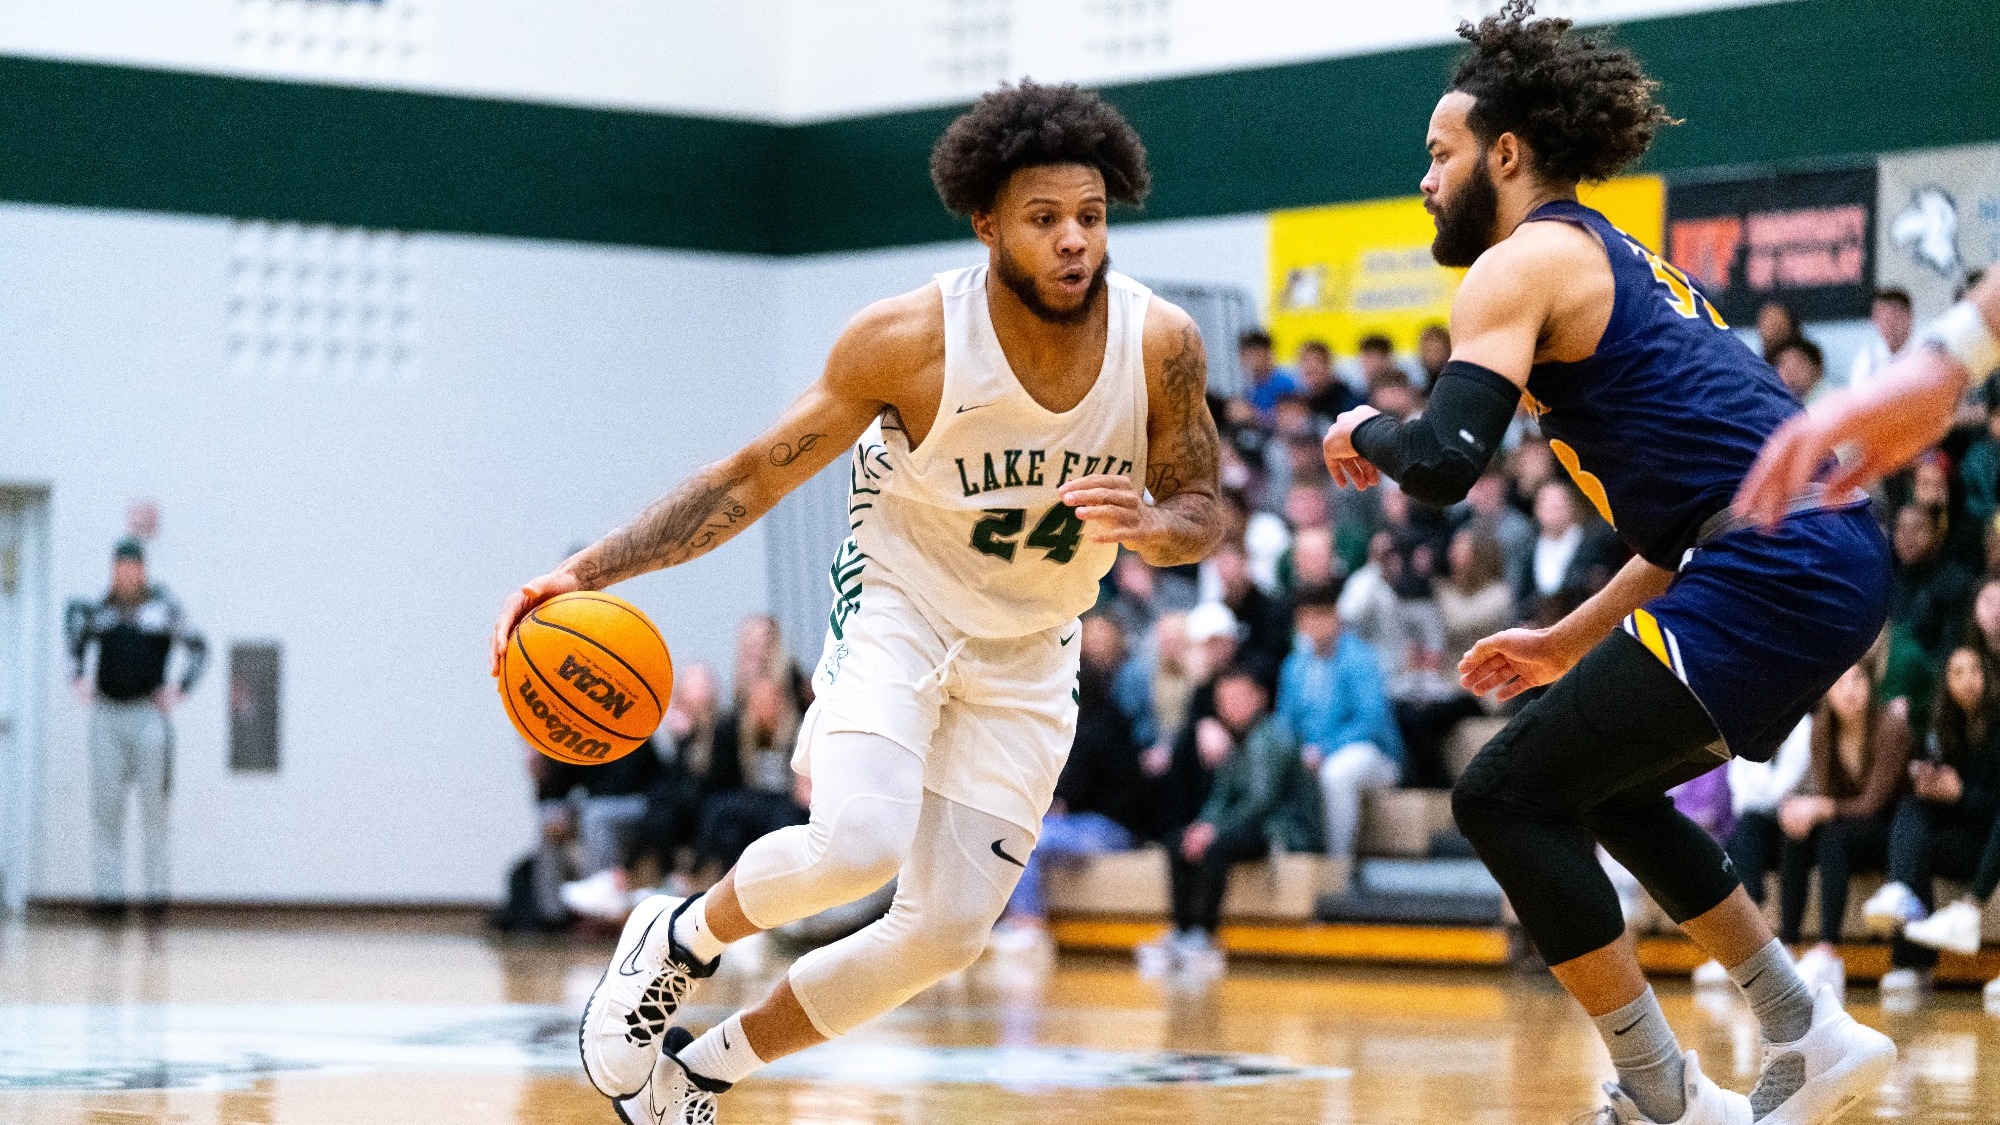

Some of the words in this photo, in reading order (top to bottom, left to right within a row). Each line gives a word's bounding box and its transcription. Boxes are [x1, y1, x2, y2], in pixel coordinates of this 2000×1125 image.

[955, 449, 1045, 497] LAKE
[968, 500, 1086, 565] 24
[519, 678, 612, 759] Wilson
[557, 654, 636, 720] NCAA
